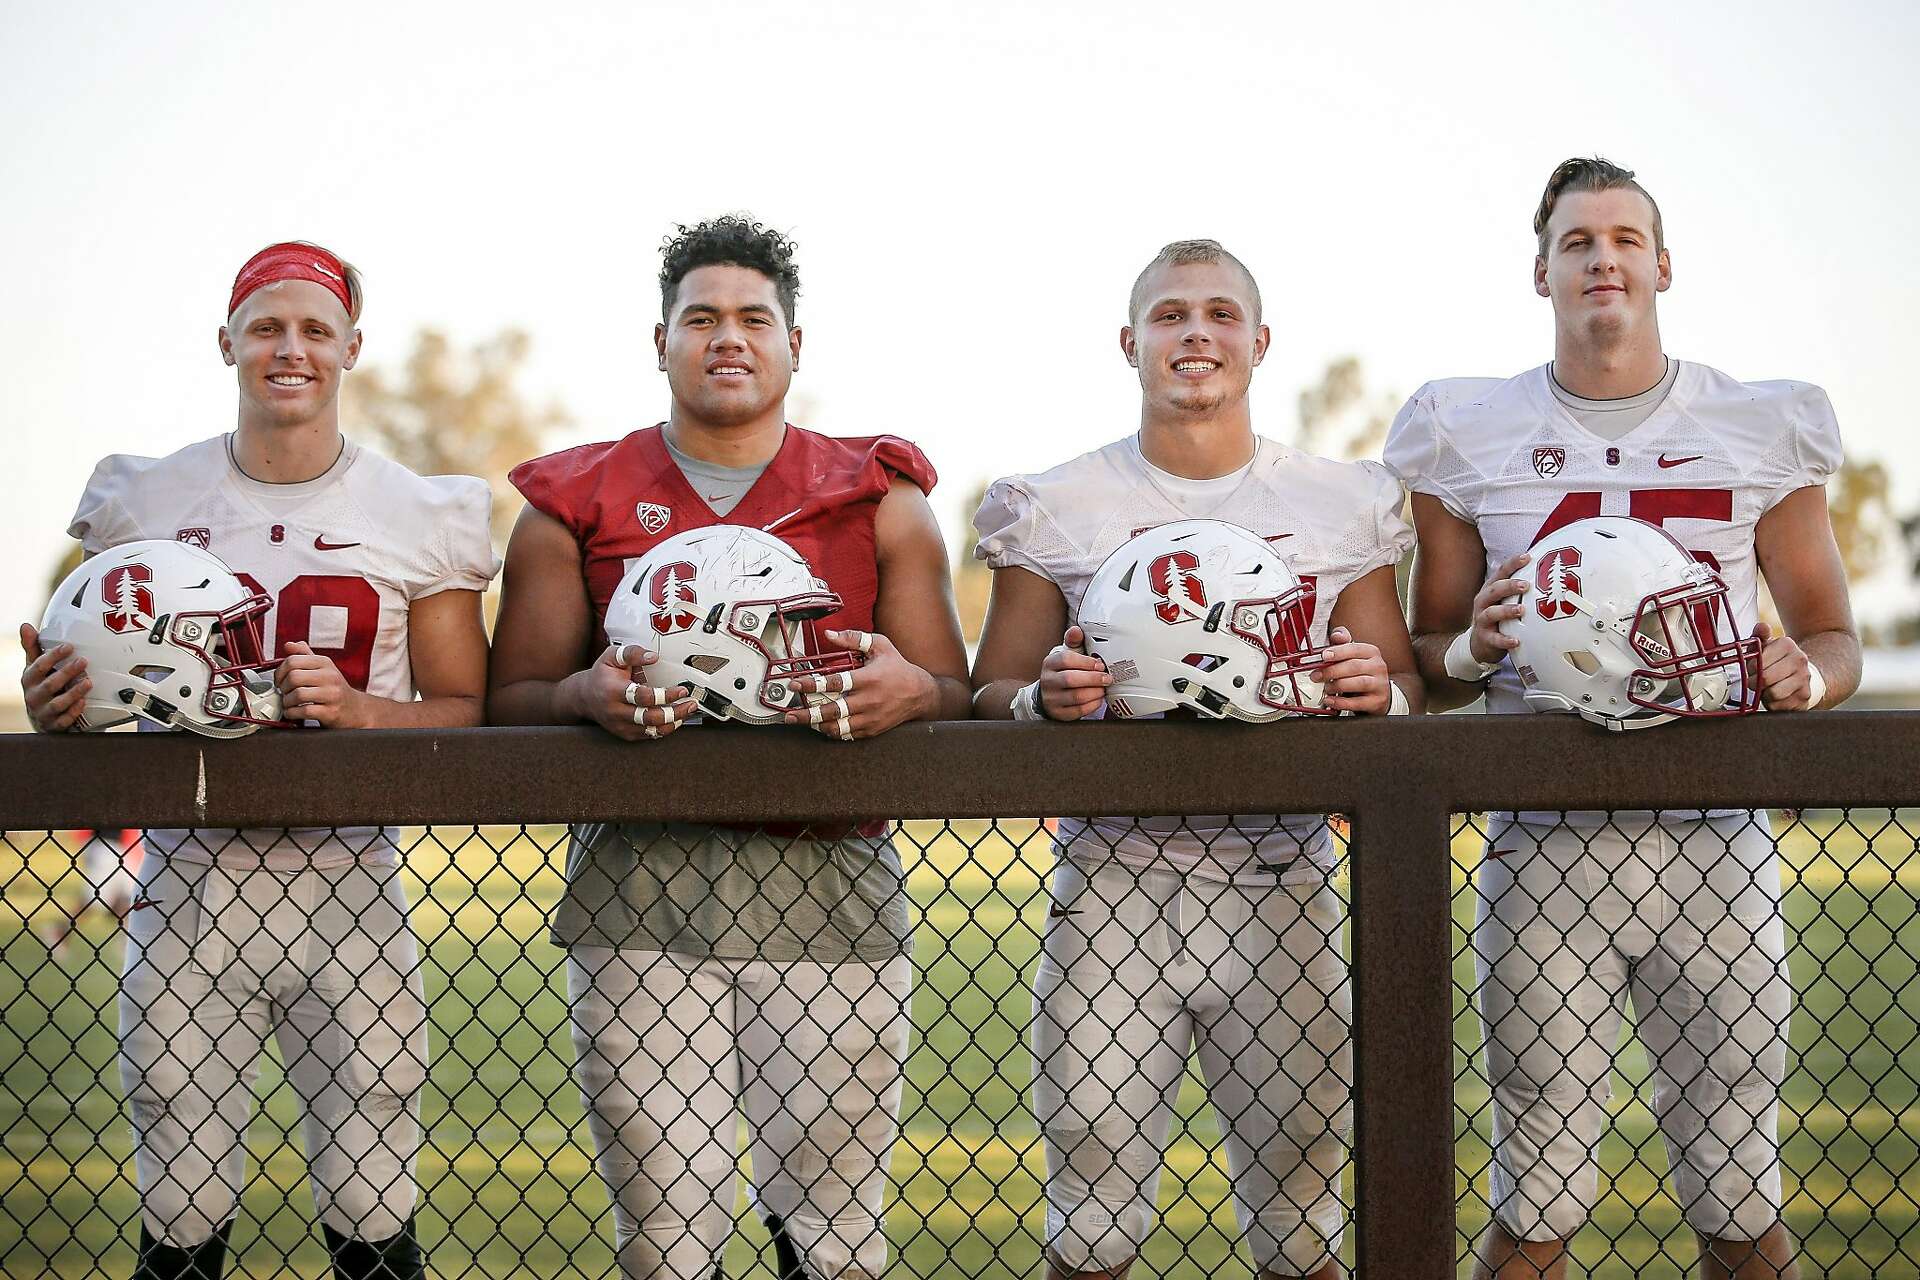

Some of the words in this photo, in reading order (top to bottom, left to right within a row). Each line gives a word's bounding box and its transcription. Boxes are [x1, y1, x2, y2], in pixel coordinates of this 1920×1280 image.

[1534, 449, 1564, 468] PAC
[1605, 447, 1620, 466] S
[1540, 462, 1556, 474] 12
[639, 503, 669, 523] PAC
[645, 515, 661, 528] 12
[1535, 546, 1583, 622] S
[101, 563, 155, 634] S
[649, 560, 698, 636] S
[1636, 635, 1672, 658] Ridde
